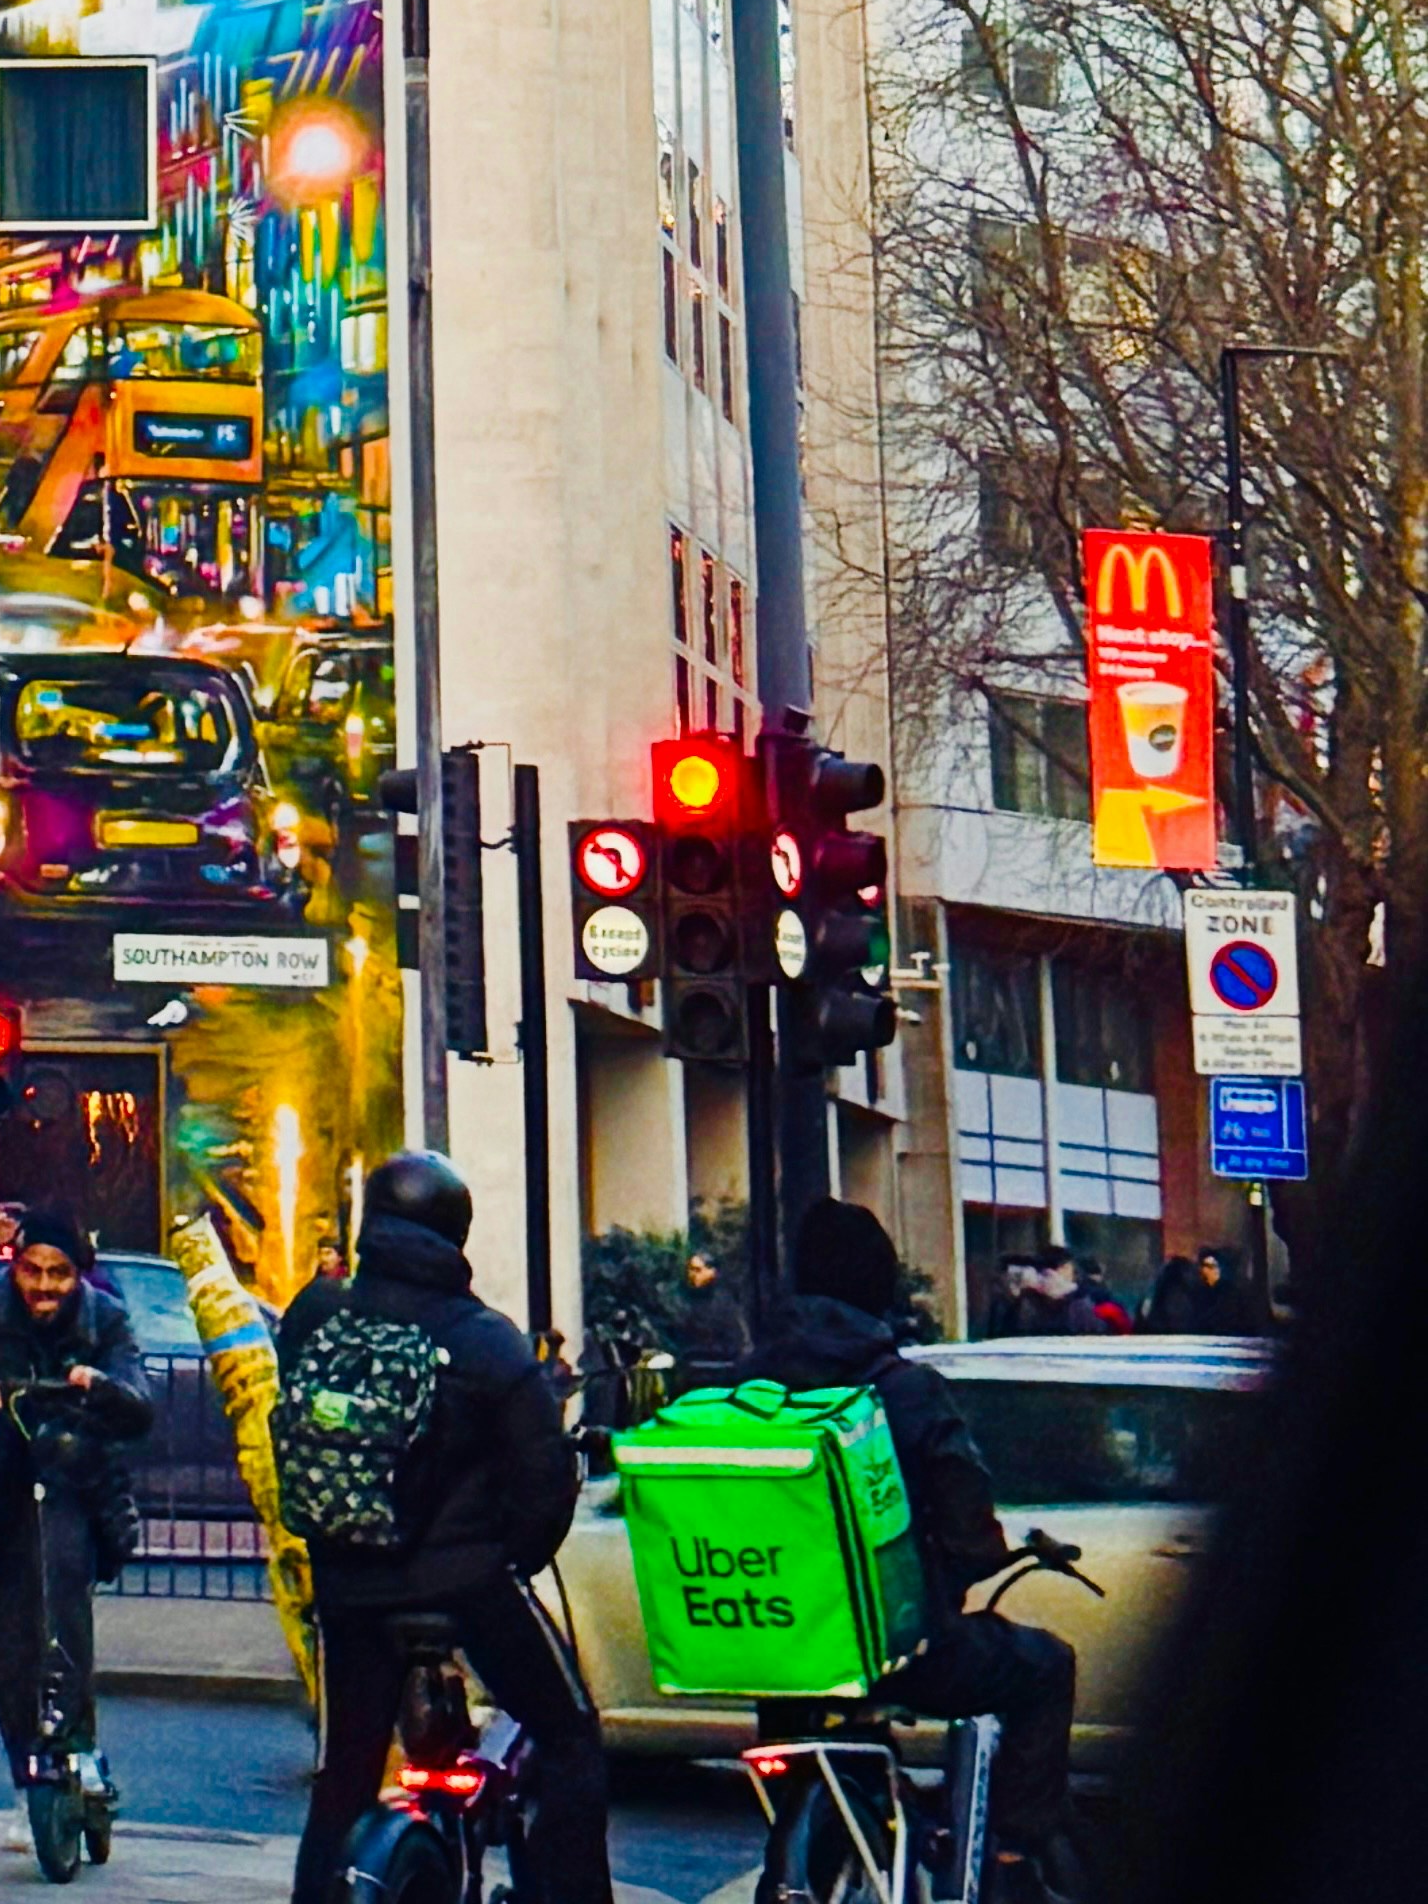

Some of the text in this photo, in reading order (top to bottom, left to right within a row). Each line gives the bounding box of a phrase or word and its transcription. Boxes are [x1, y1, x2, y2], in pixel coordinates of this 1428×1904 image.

[1190, 893, 1288, 912] Controlled
[1206, 915, 1275, 935] ZONE
[121, 948, 320, 971] SOUTHAMPTON ROW
[670, 1536, 783, 1579] Uber
[685, 1584, 795, 1631] Eats
